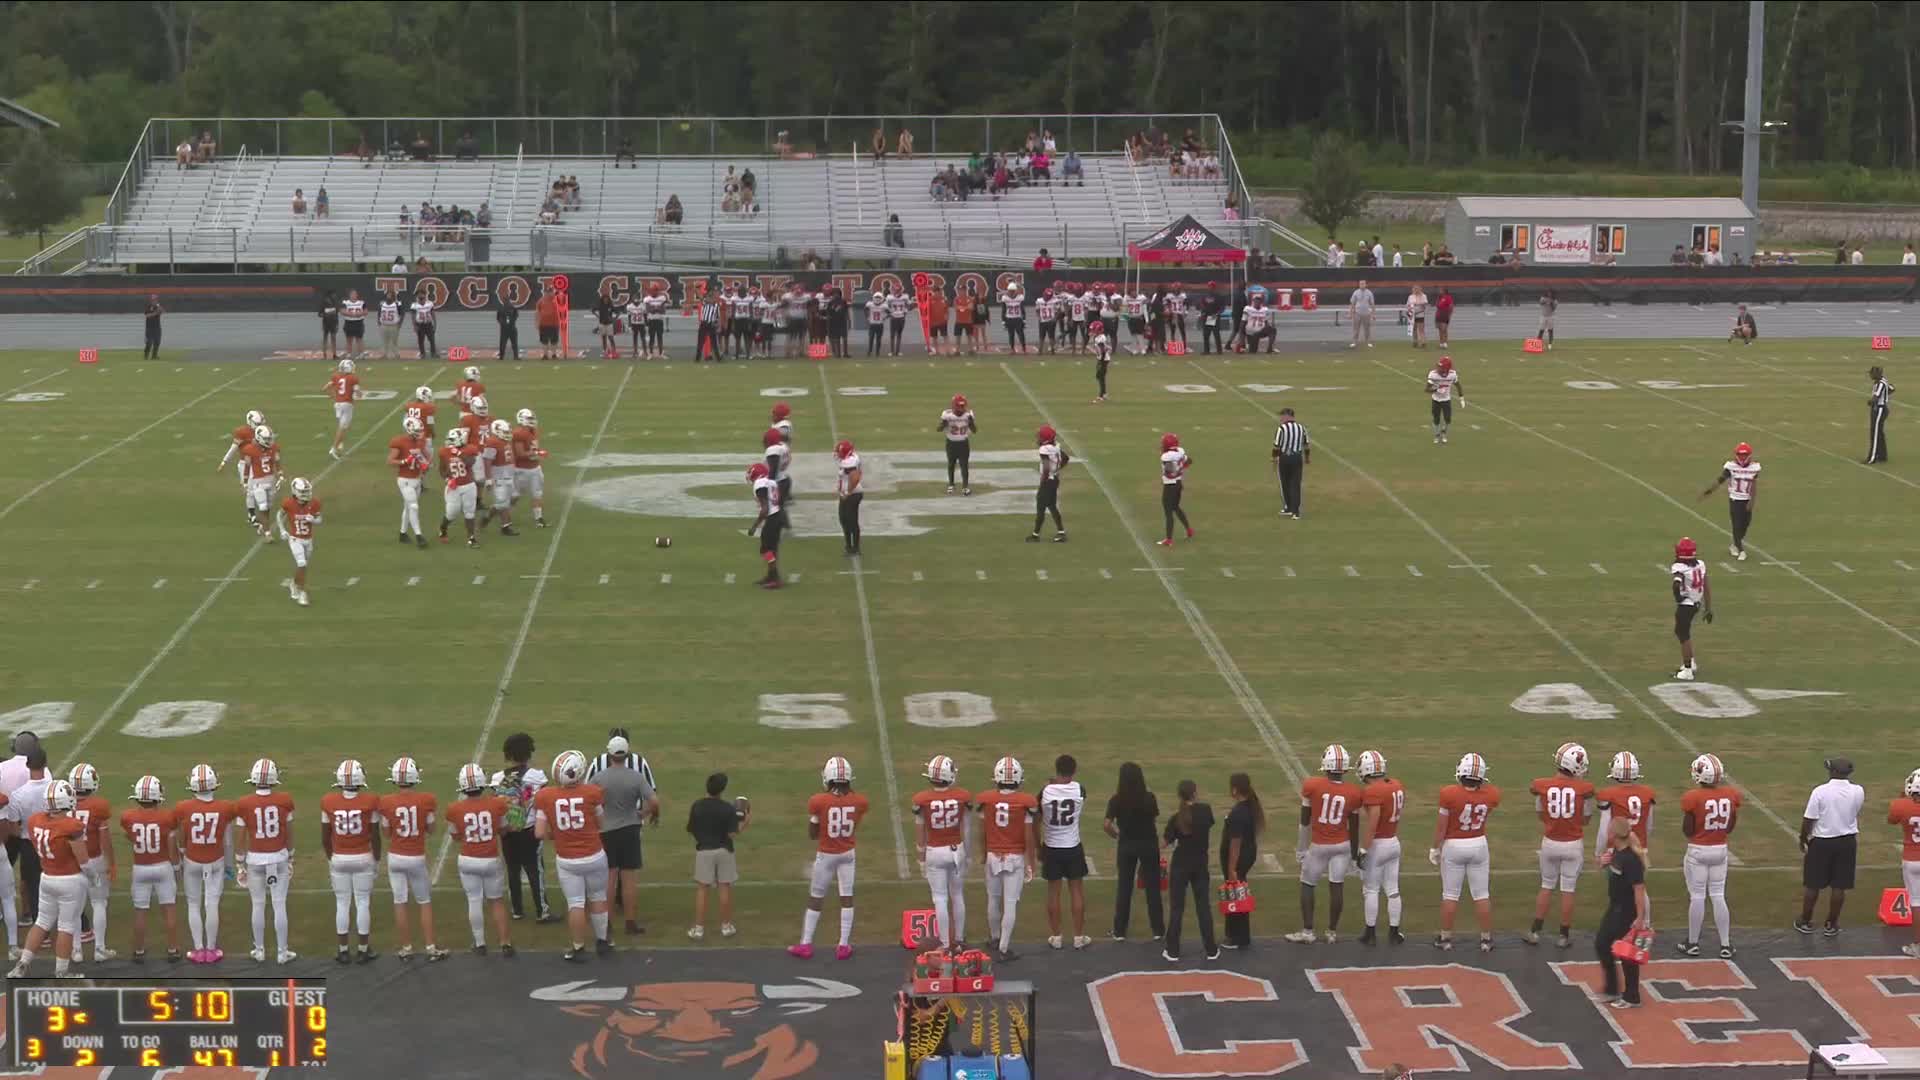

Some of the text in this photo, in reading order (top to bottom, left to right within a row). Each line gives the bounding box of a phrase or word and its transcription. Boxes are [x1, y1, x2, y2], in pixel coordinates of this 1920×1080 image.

[375, 276, 566, 309] TOCO
[338, 378, 346, 394] 3
[261, 456, 270, 473] 5
[449, 463, 466, 478] 58
[294, 519, 310, 535] 15
[555, 797, 586, 831] 65
[930, 799, 959, 829] 22
[1050, 799, 1075, 826] 12
[1318, 793, 1346, 825] 10
[1459, 803, 1488, 831] 43
[1547, 787, 1576, 819] 80
[1627, 795, 1642, 826] 9
[1704, 799, 1732, 831] 29
[191, 812, 219, 844] 27
[254, 806, 280, 839] 18
[395, 806, 419, 838] 31
[464, 811, 493, 843] 28
[828, 807, 855, 838] 85
[33, 827, 55, 859] 71
[132, 824, 161, 854] 30
[1228, 902, 1237, 913] G
[930, 981, 940, 992] G
[972, 979, 982, 990] G
